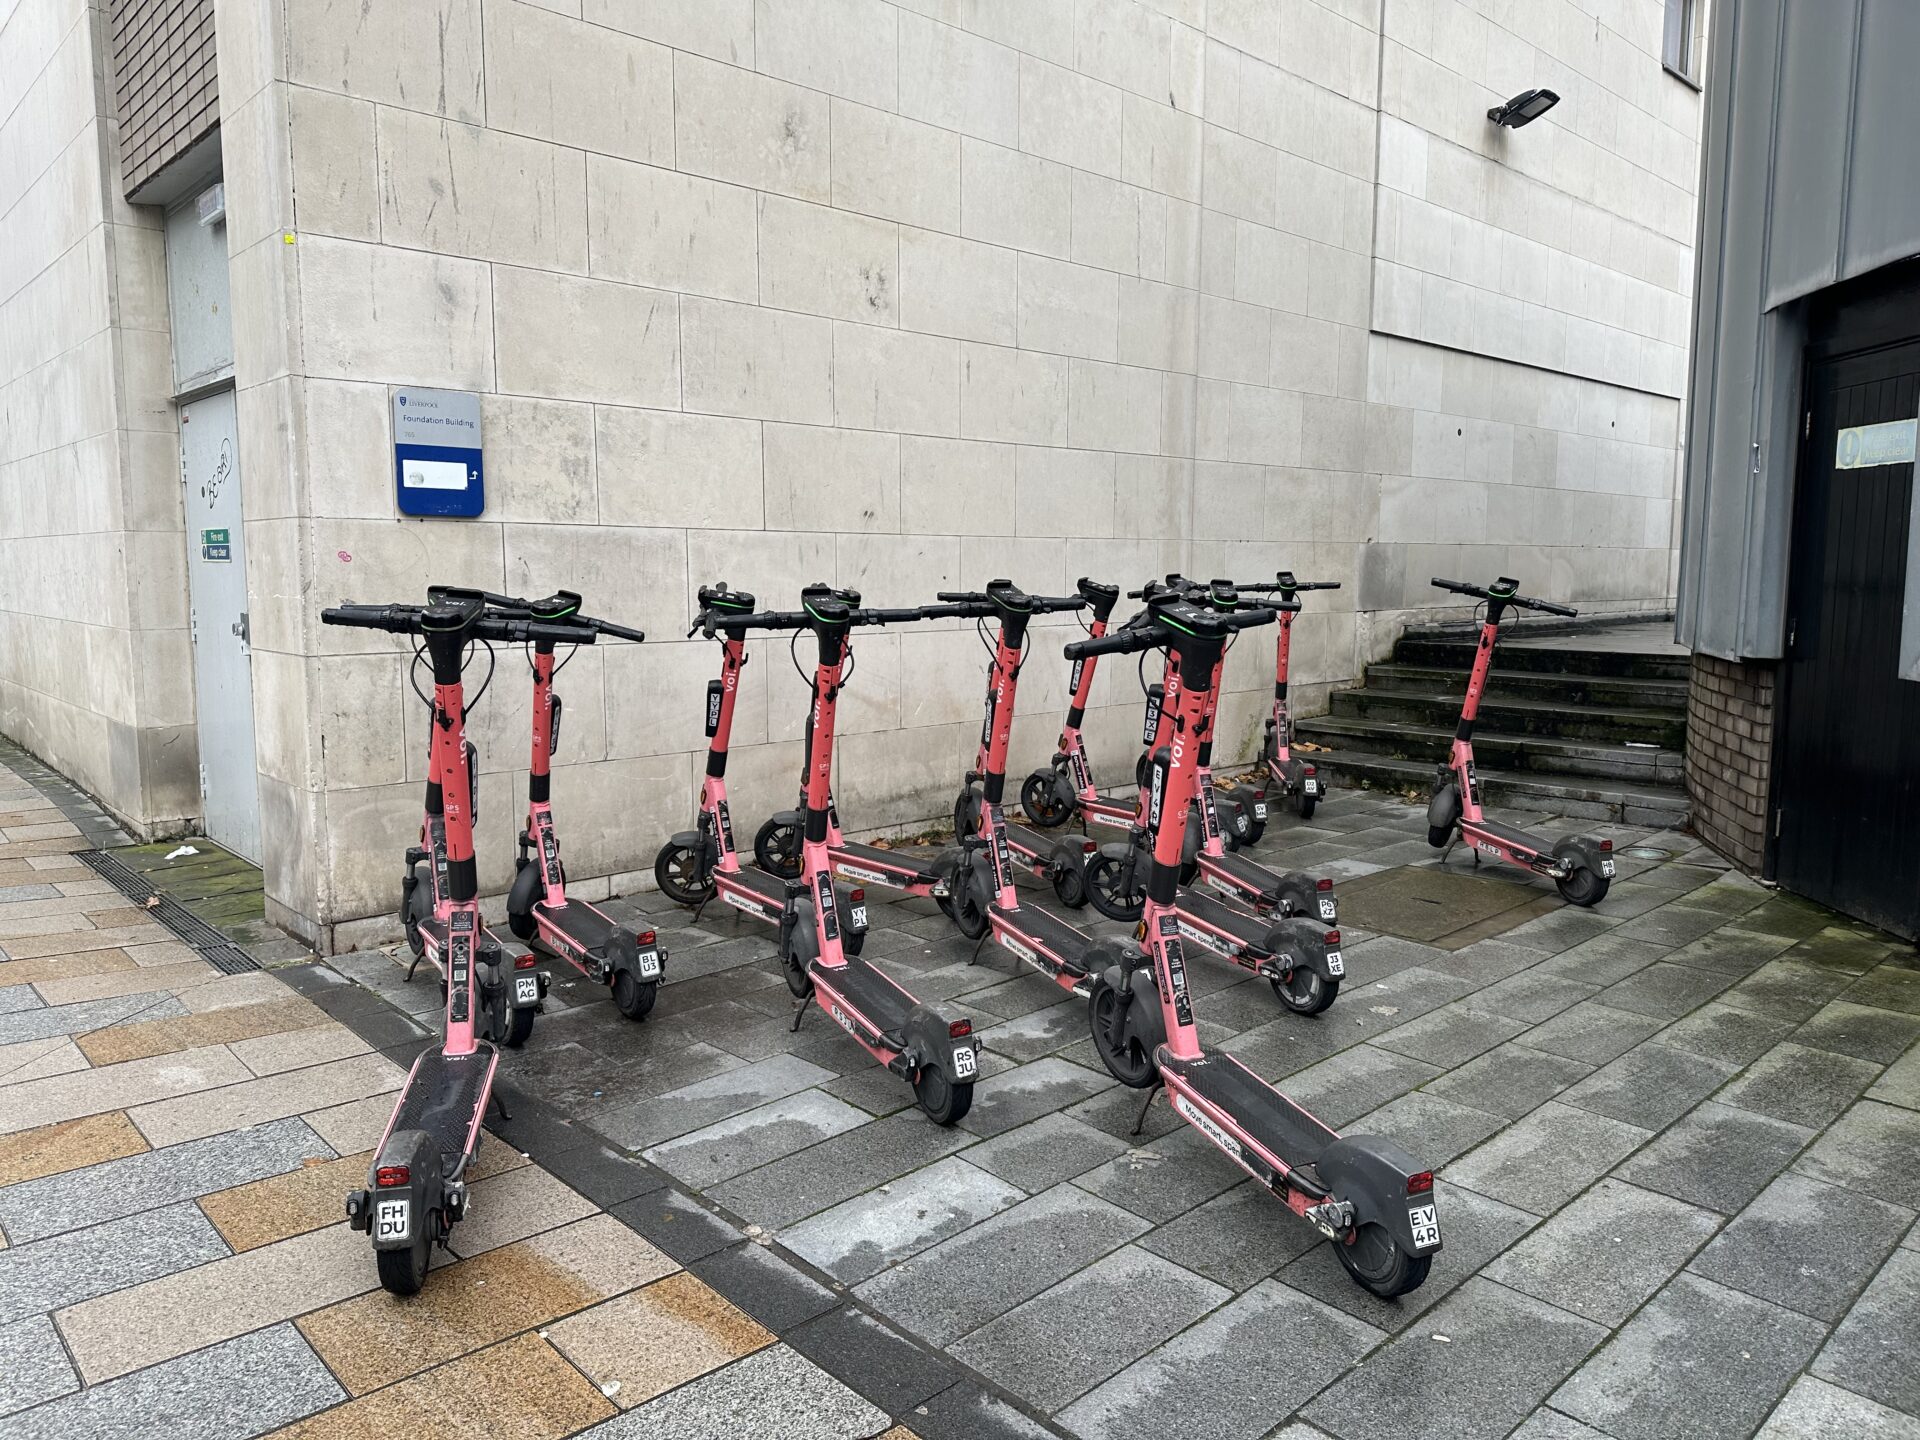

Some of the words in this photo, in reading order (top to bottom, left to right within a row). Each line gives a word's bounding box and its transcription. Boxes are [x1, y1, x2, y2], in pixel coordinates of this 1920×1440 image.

[403, 414, 444, 424] Foundation
[445, 417, 474, 428] Building
[725, 669, 737, 693] voi.
[1167, 673, 1181, 698] voi.
[544, 684, 553, 711] voi.
[996, 679, 1006, 704] voi.
[814, 700, 822, 729] voi.
[1170, 734, 1187, 769] voi.
[843, 866, 857, 876] Move
[728, 895, 740, 904] Move
[853, 908, 865, 917] YY
[854, 918, 866, 926] PL
[642, 954, 656, 964] BL
[1329, 955, 1339, 964] J3
[643, 962, 657, 972] U3
[1331, 964, 1342, 973] XE
[518, 979, 535, 989] PM
[520, 989, 535, 999] AG
[956, 1050, 972, 1063] RS
[958, 1061, 973, 1074] JU
[1185, 1104, 1204, 1126] Move
[1202, 1121, 1223, 1145] smart,
[381, 1205, 404, 1220] FH
[1410, 1207, 1434, 1227] EV
[380, 1220, 405, 1235] DU
[1415, 1227, 1437, 1243] 4R
